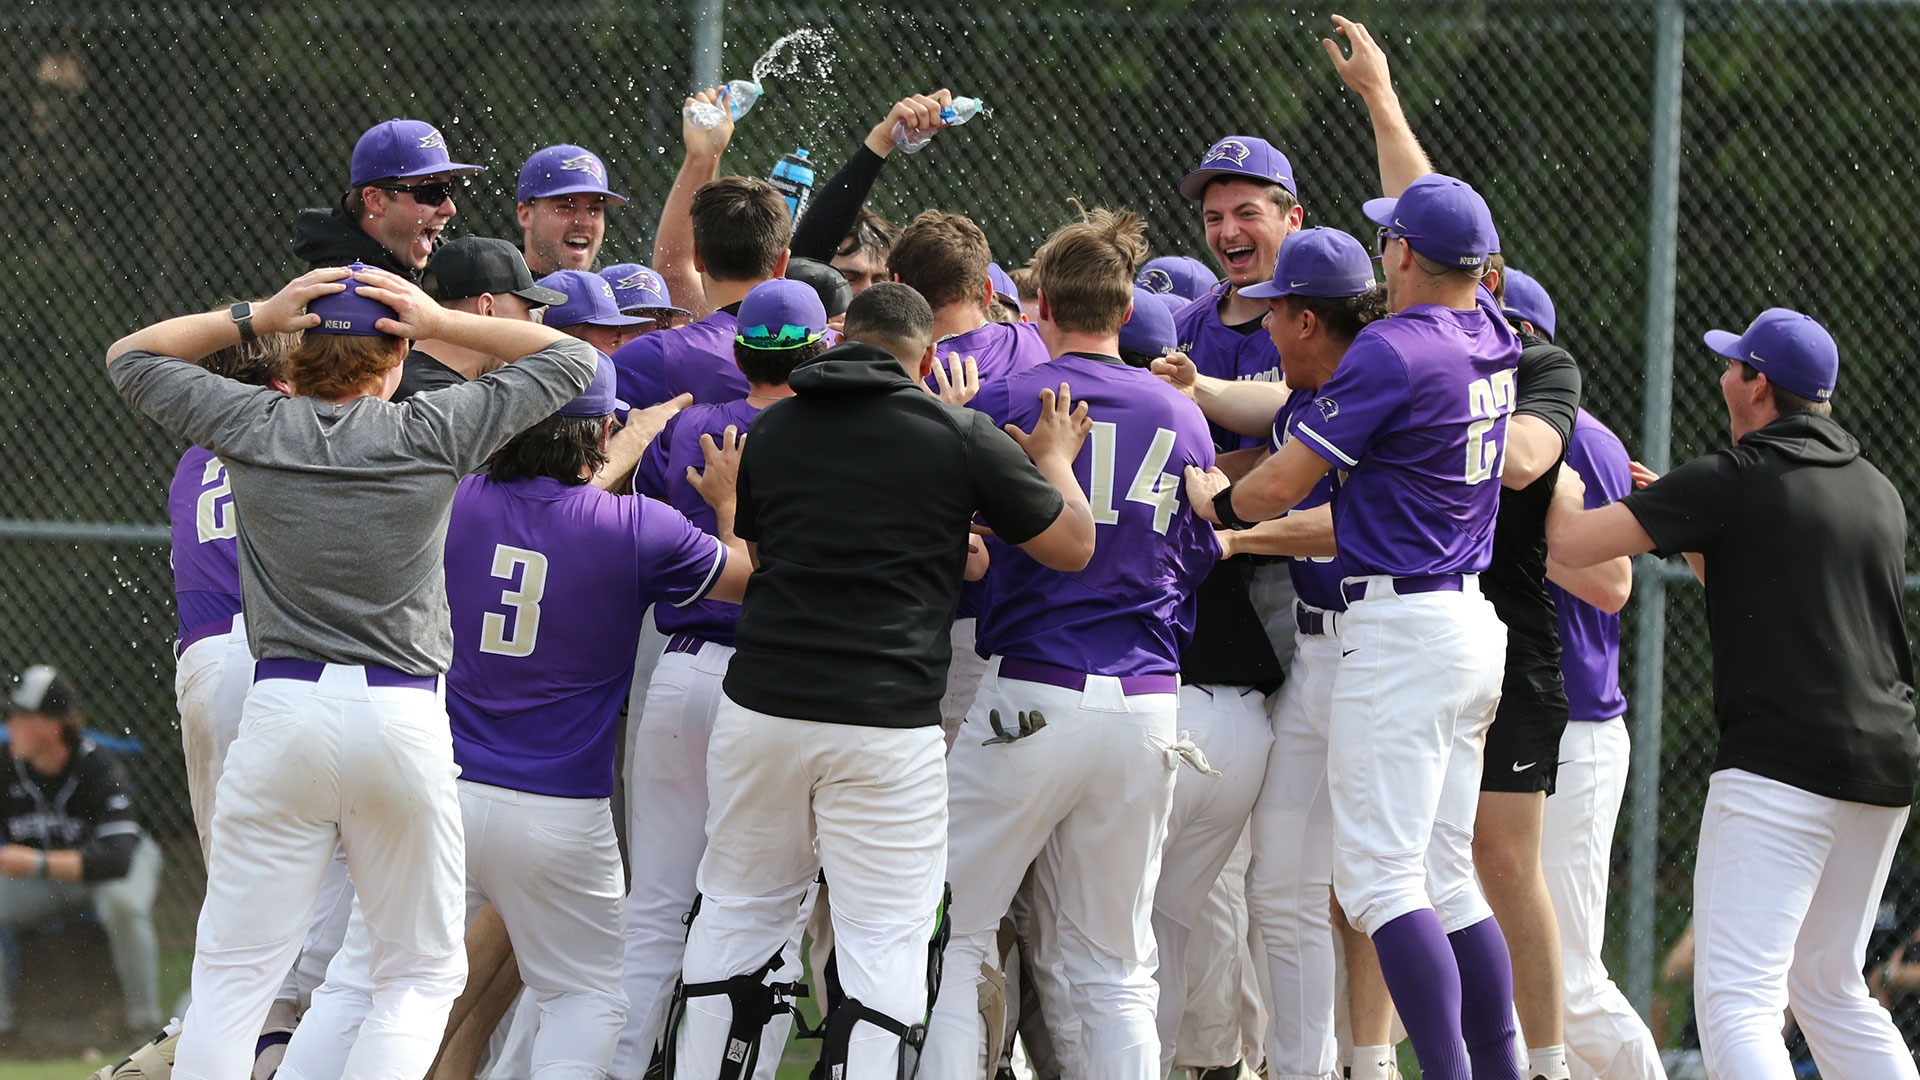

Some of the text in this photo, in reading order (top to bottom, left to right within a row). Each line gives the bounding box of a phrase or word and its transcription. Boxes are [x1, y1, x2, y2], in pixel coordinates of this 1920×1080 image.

[1088, 420, 1181, 537] 14
[1465, 367, 1518, 485] 27
[196, 456, 237, 544] 2
[479, 543, 549, 658] 3
